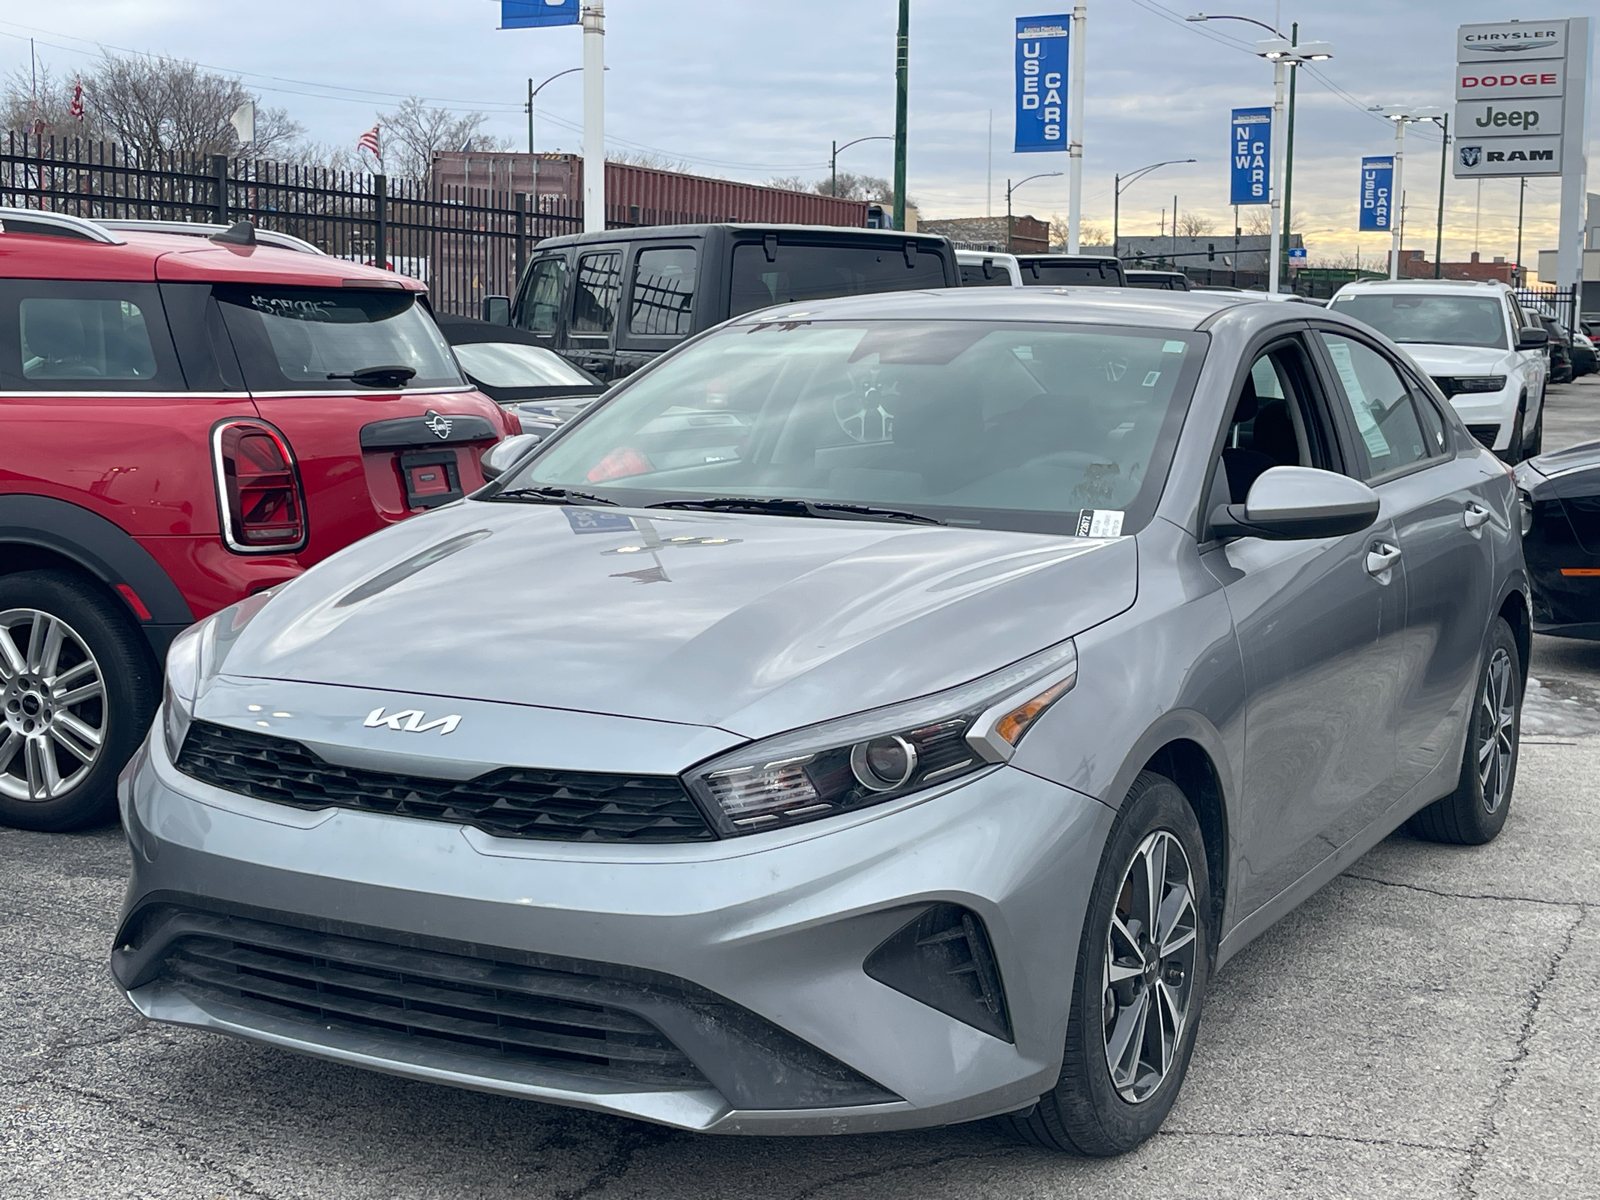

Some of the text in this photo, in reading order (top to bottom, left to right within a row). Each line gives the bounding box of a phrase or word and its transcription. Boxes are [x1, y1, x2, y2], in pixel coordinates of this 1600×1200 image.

[1465, 31, 1556, 42] CHRYSLER
[1022, 42, 1040, 110] USED
[1462, 74, 1557, 88] DODGE
[1043, 72, 1062, 141] CARS
[1476, 107, 1539, 130] Jeep
[1235, 127, 1251, 170] NEW
[1487, 150, 1553, 162] RAM
[1251, 142, 1265, 197] CARS
[1363, 170, 1376, 209] USED
[1376, 188, 1388, 226] CARS
[363, 706, 462, 736] KIA
